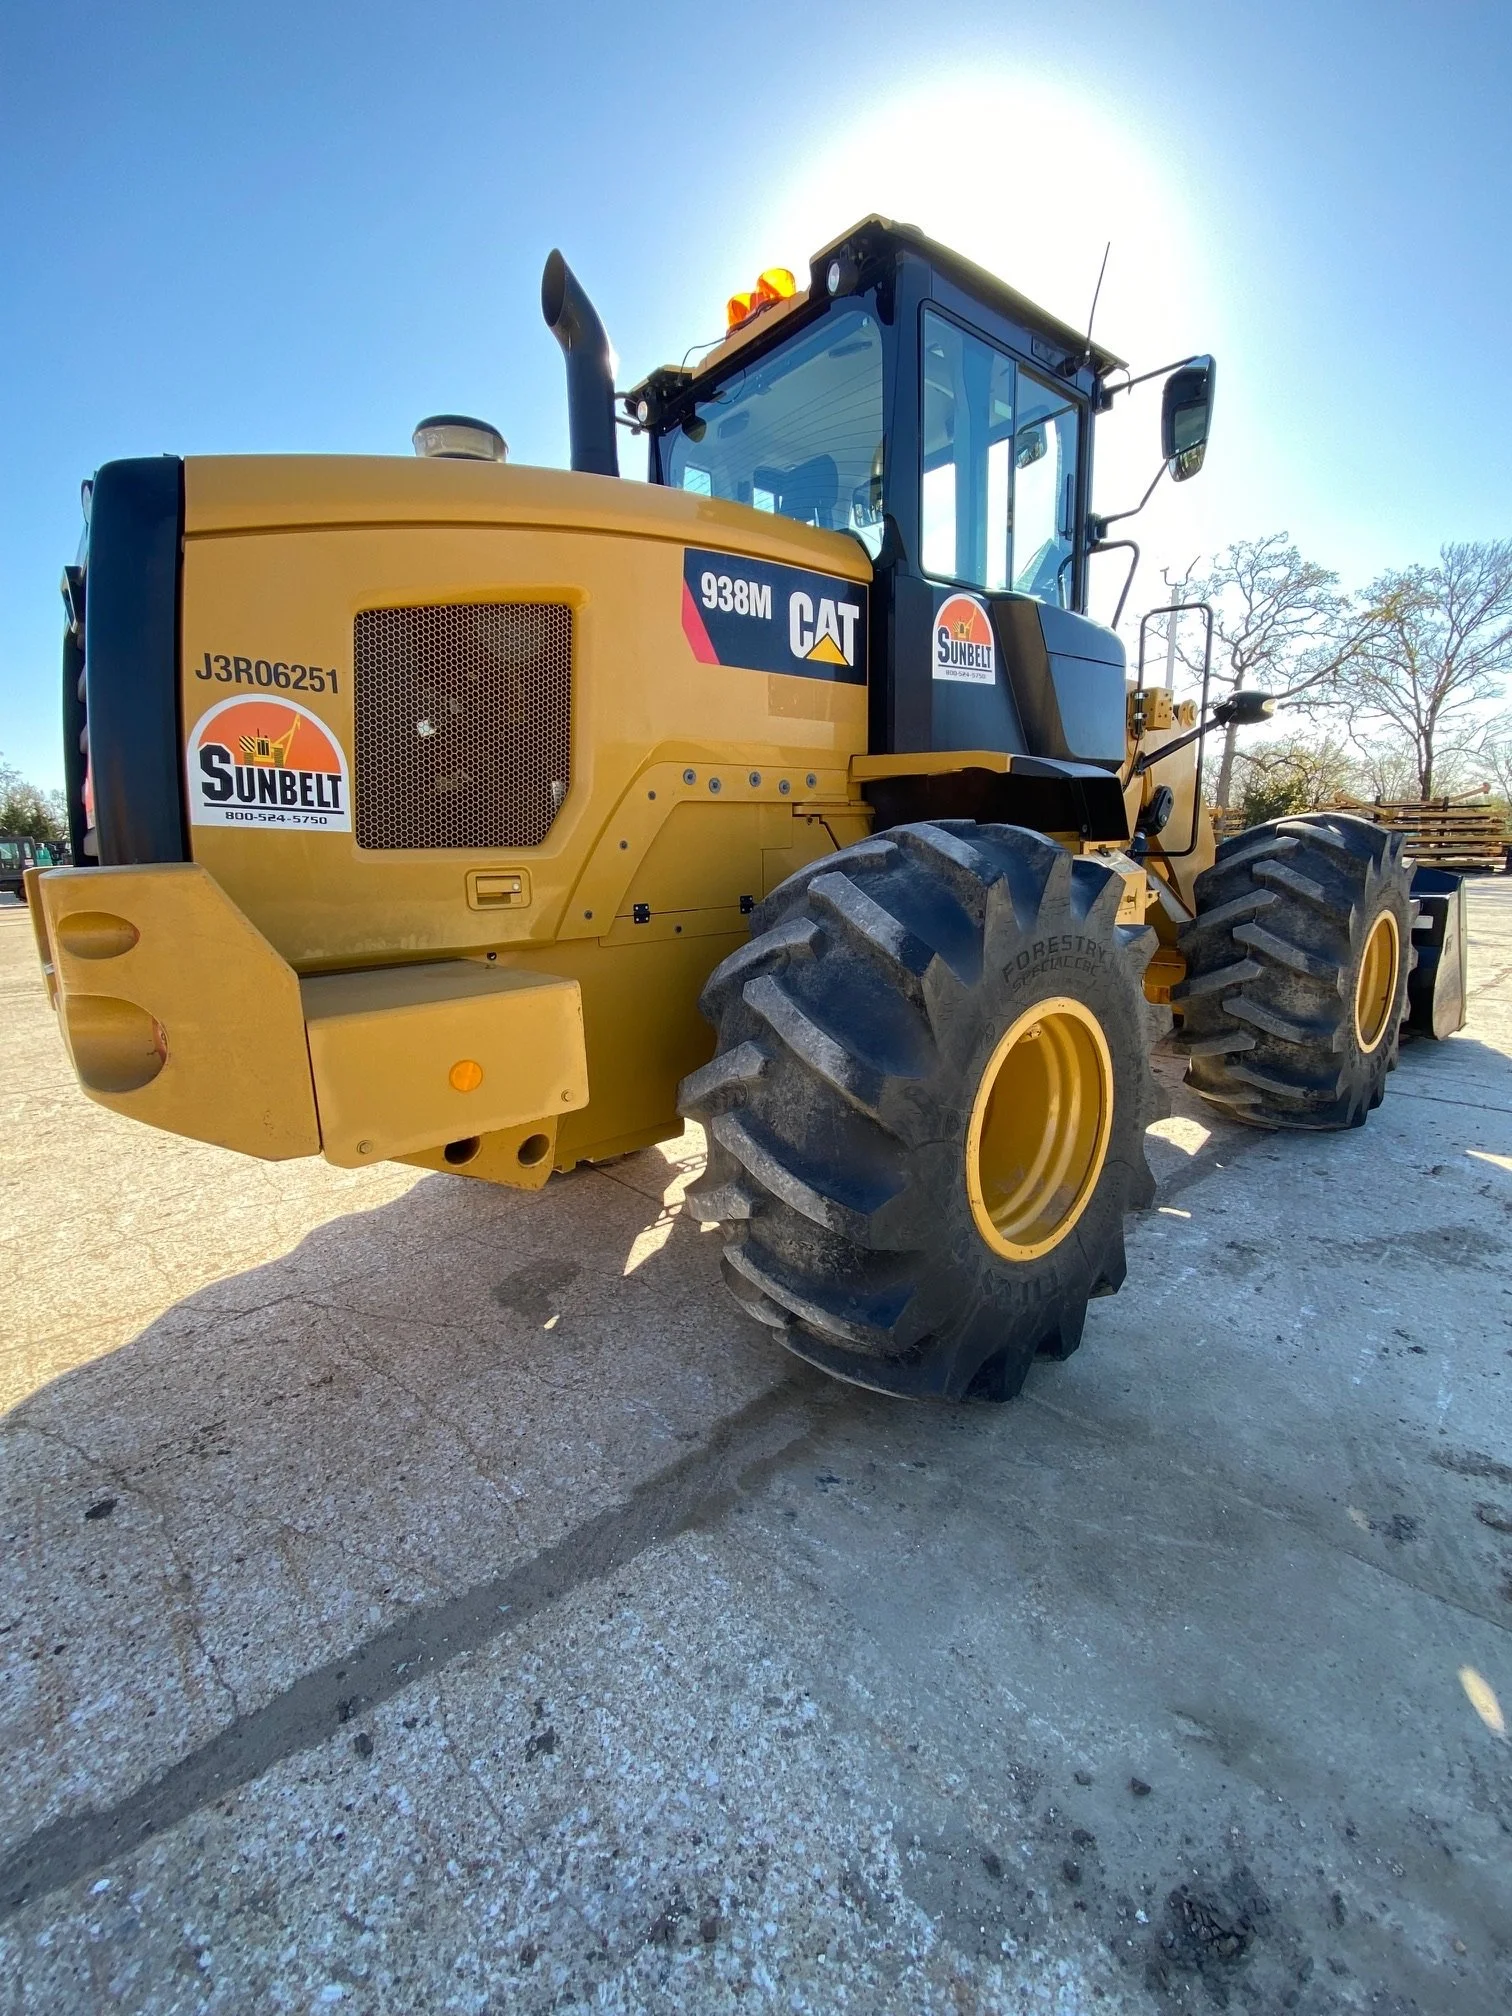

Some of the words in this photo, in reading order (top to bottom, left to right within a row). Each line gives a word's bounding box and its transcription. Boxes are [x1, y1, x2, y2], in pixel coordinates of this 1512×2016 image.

[701, 571, 772, 620] 938M
[789, 591, 860, 667] CAT
[937, 626, 992, 669] SUNBELT
[195, 652, 339, 694] J3R06251
[945, 669, 986, 679] 800-524-5750
[199, 743, 342, 809] SUNBELT
[225, 811, 328, 825] 800-524-5750
[1002, 934, 1108, 984] FORESTRY
